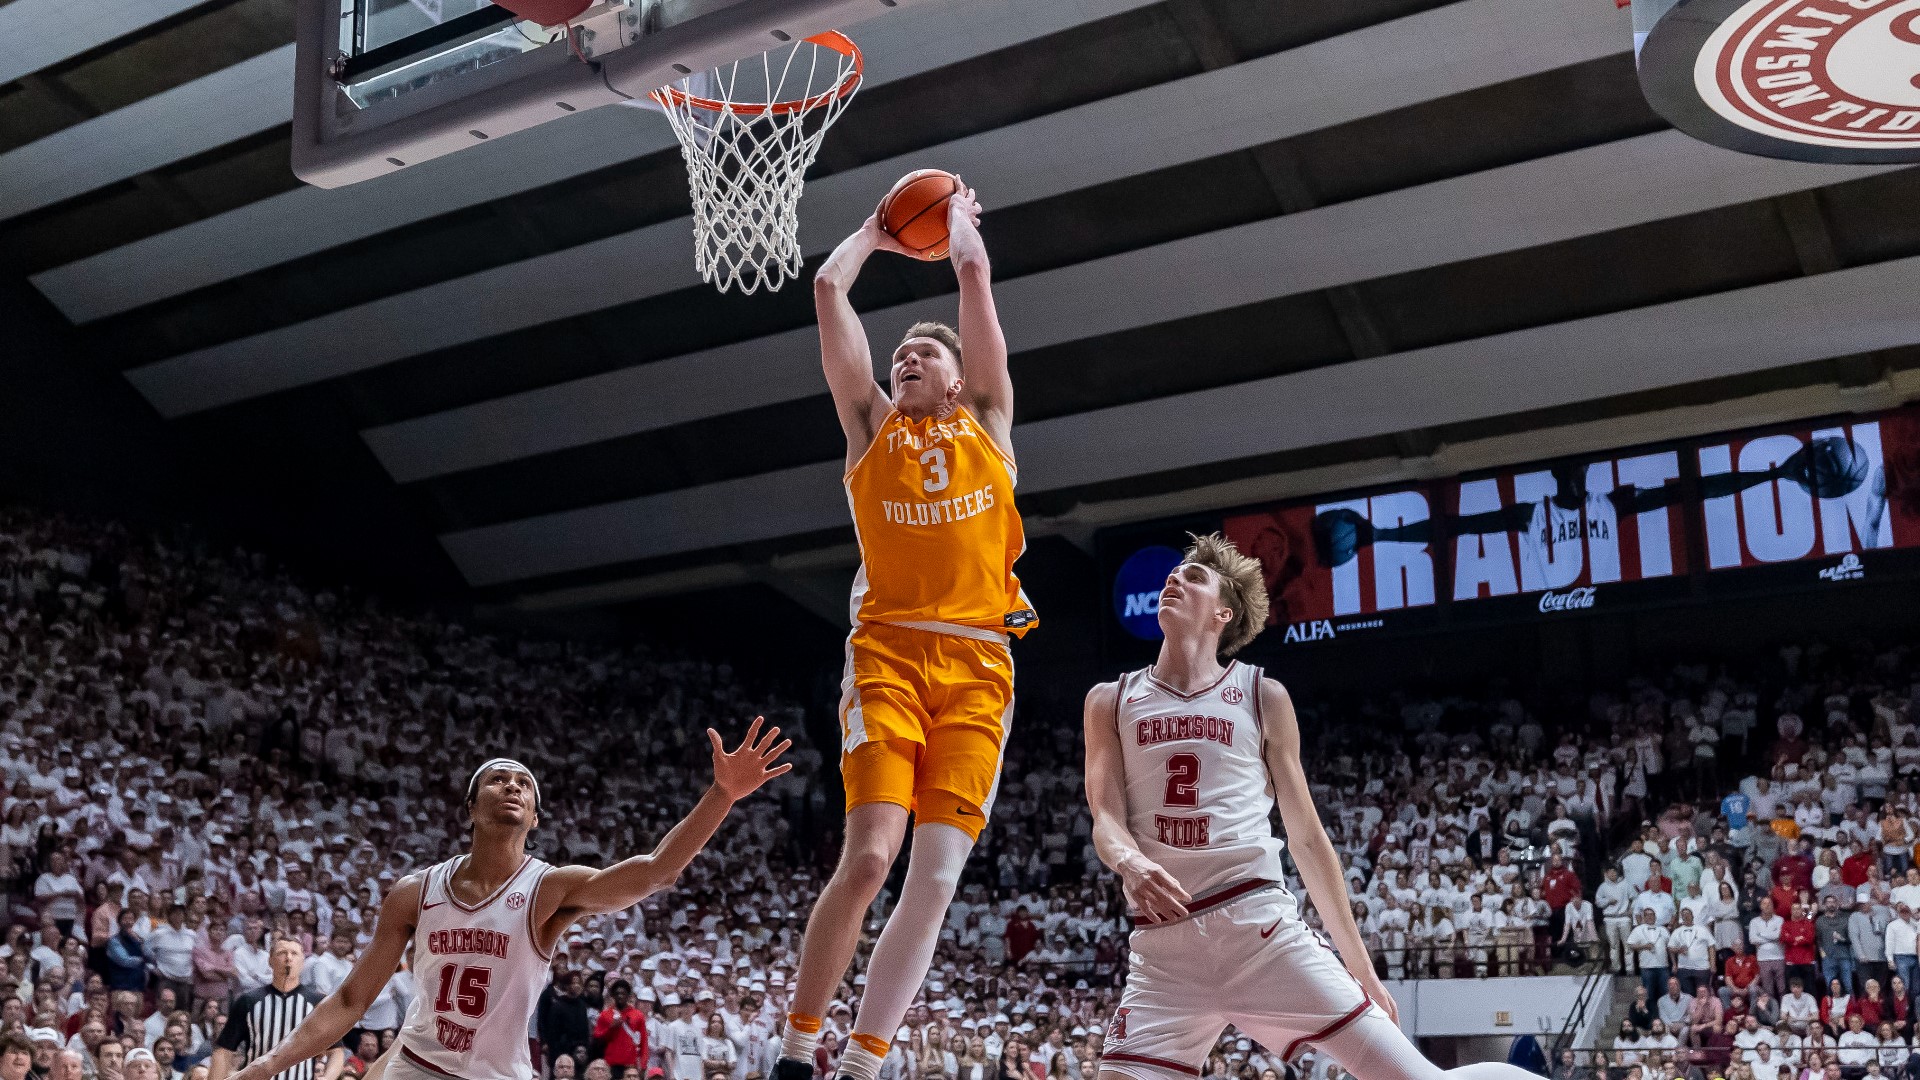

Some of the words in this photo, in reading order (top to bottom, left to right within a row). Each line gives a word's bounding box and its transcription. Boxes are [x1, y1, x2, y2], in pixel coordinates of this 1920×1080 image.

[920, 447, 950, 493] 3
[881, 484, 995, 526] VOLUNTEERS
[1315, 421, 1894, 616] TRADITION
[1124, 590, 1160, 617] NC
[1283, 619, 1336, 644] ALFA
[1222, 687, 1243, 704] SEC
[1136, 714, 1234, 747] CRIMSON
[1163, 752, 1201, 808] 2
[1154, 814, 1210, 847] TIDE
[428, 928, 509, 959] CRIMSON
[434, 962, 492, 1018] 15
[436, 1015, 476, 1053] TIDE
